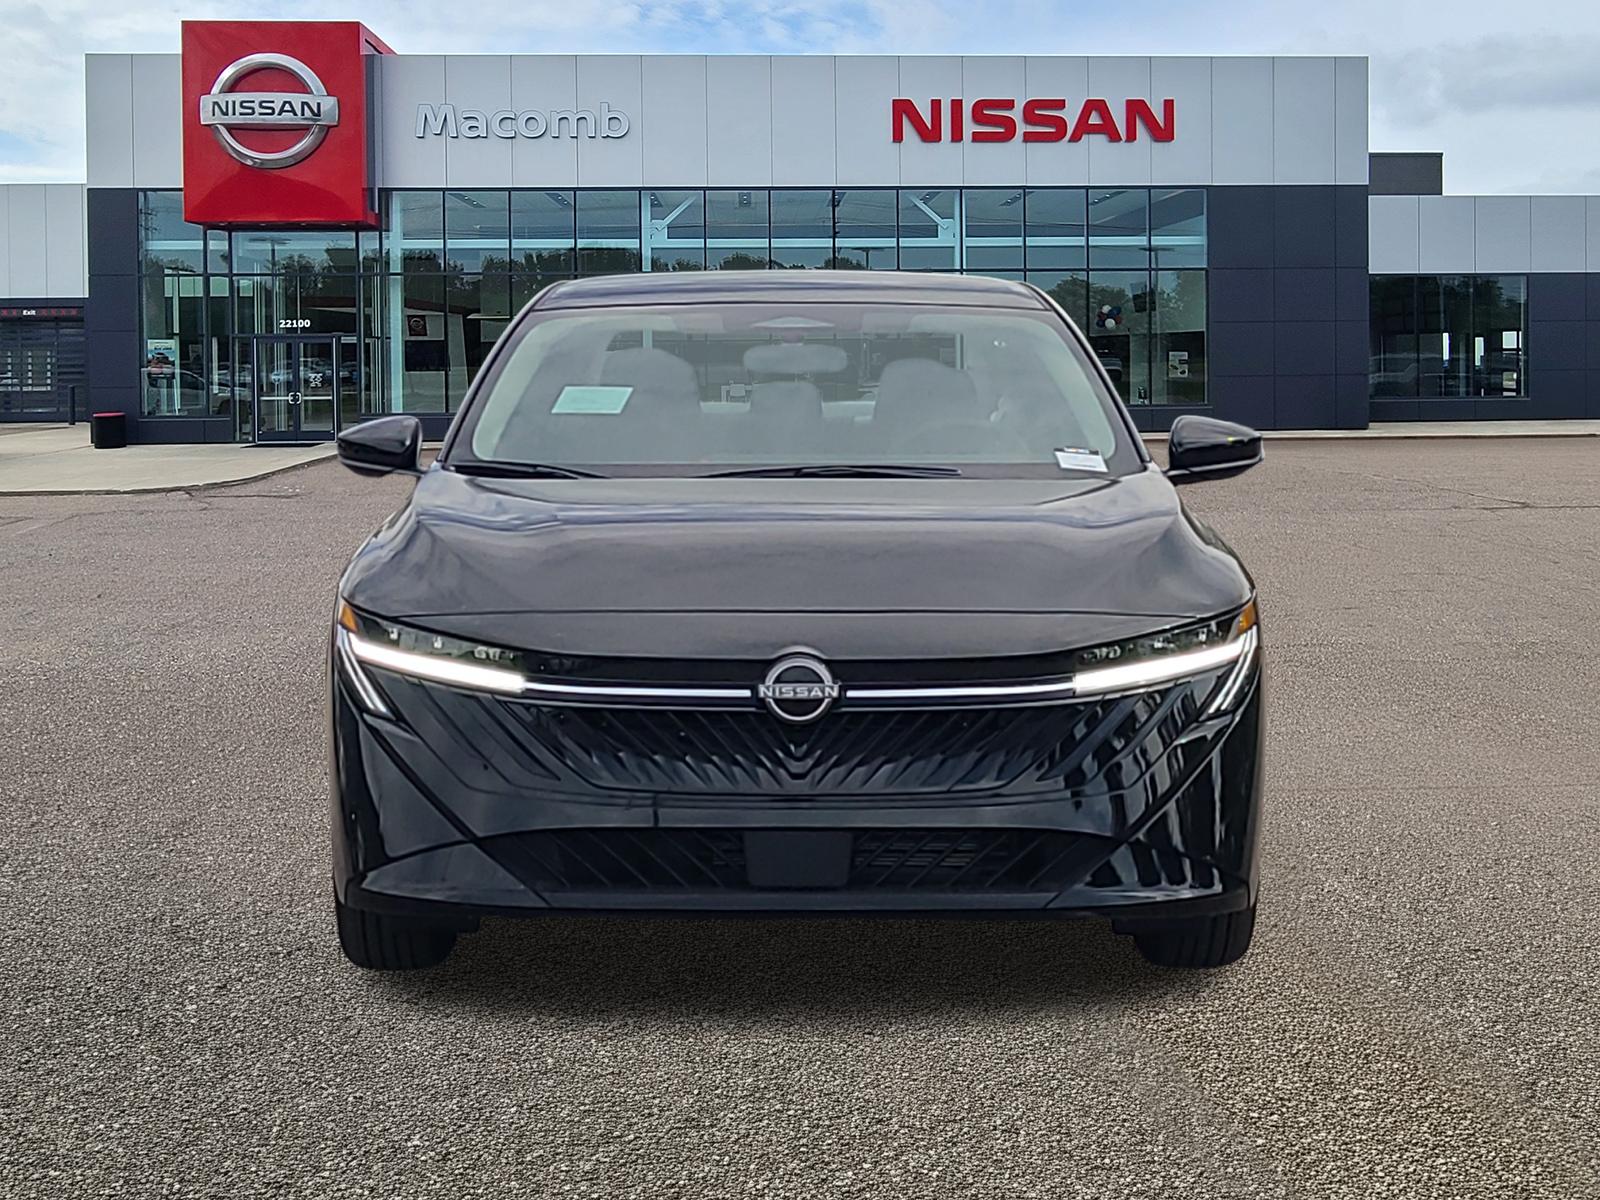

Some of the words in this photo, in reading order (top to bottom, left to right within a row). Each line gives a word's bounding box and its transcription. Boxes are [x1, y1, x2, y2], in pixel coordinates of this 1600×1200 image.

[212, 100, 322, 117] NISSAN
[415, 101, 630, 139] Macomb
[892, 98, 1175, 143] NISSAN
[279, 319, 311, 328] 22100
[759, 685, 839, 698] NISSAN
